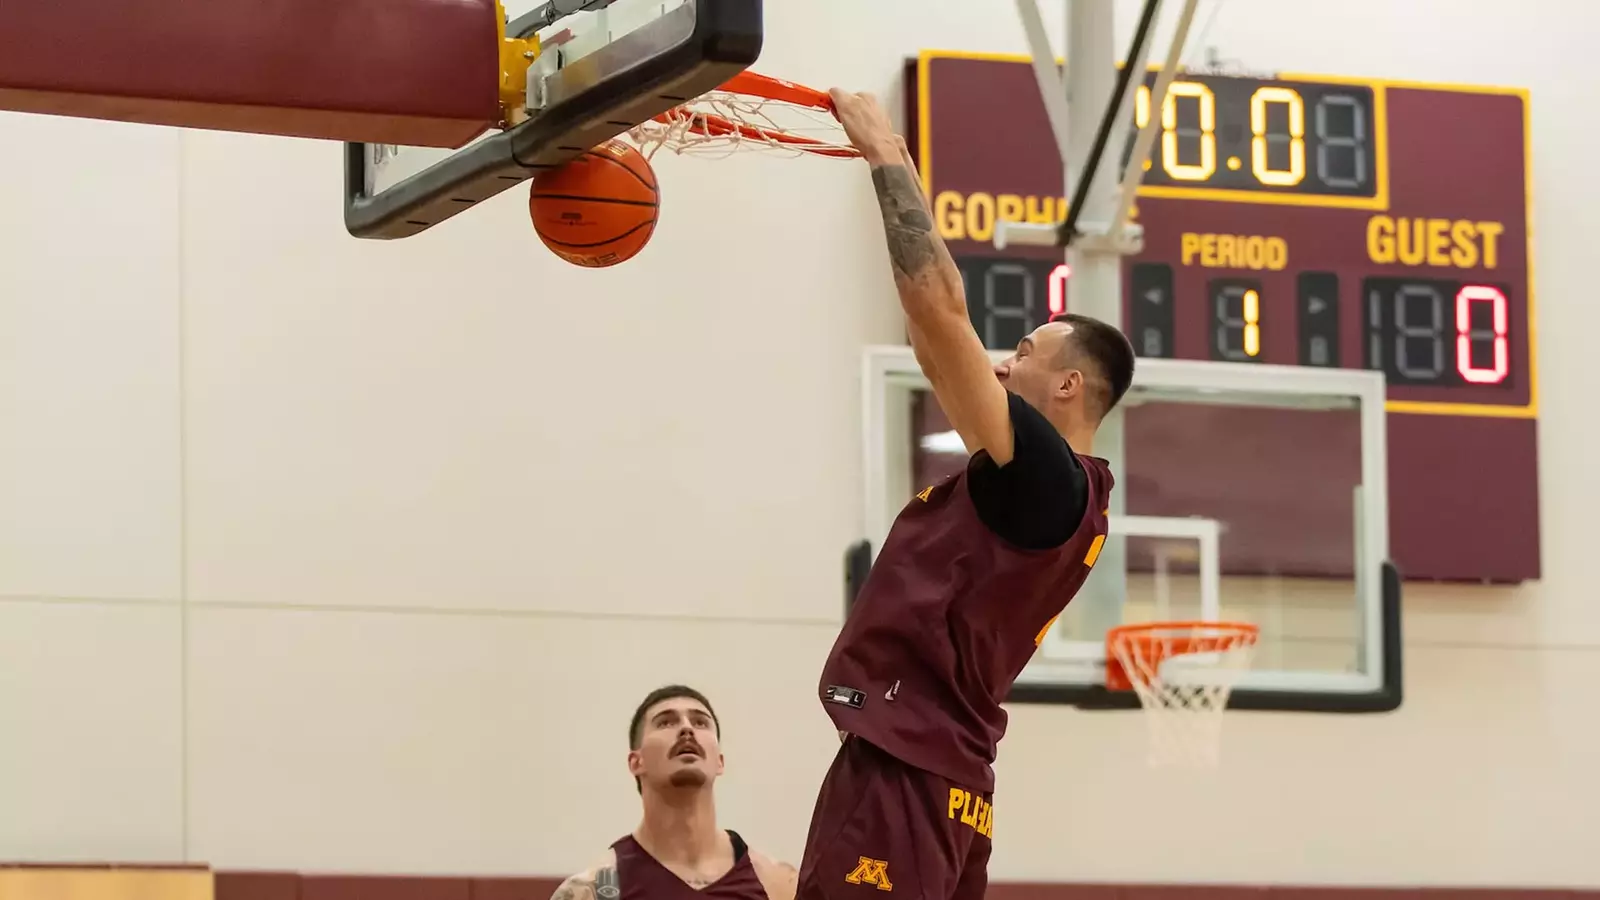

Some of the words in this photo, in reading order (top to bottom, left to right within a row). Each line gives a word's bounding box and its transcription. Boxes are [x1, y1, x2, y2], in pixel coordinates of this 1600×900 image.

[1182, 233, 1287, 270] PERIOD
[1367, 215, 1503, 269] GUEST
[1243, 289, 1260, 357] 1
[1455, 285, 1510, 385] 0
[845, 856, 893, 892] M
